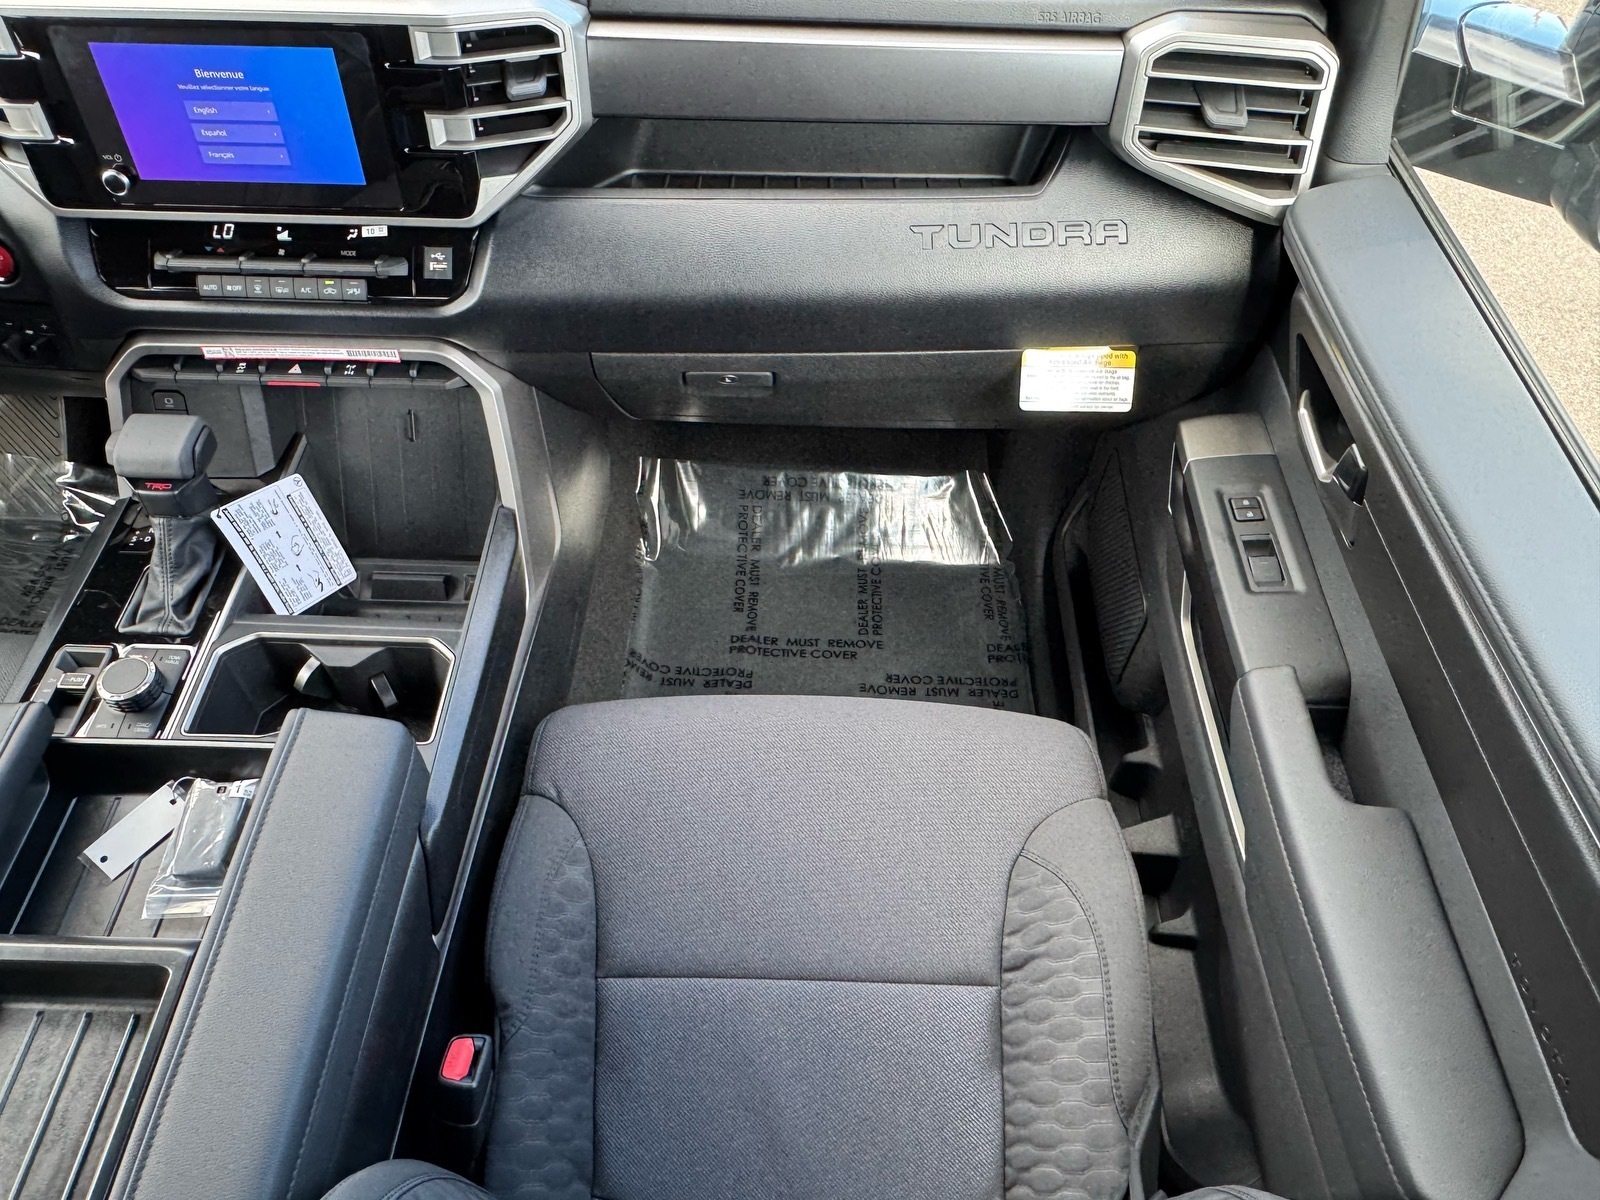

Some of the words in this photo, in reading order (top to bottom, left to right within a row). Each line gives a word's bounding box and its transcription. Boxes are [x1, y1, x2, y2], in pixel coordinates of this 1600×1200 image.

[1037, 11, 1058, 22] SRS
[1061, 11, 1102, 24] AIRBAG
[193, 68, 244, 79] Bienvenue
[193, 106, 218, 115] English
[201, 129, 228, 137] Español
[208, 151, 235, 159] Français
[212, 223, 235, 240] LO
[908, 218, 1129, 250] TUNDRA
[145, 482, 173, 491] TRD
[738, 489, 791, 501] REMOVE
[799, 490, 830, 502] MUST
[750, 505, 762, 552] DEALER
[131, 535, 138, 543] S
[144, 535, 152, 543] D
[735, 504, 749, 577] PROTECTIVE
[748, 559, 762, 586] MUST
[856, 568, 868, 594] MUST
[993, 567, 1006, 594] MUST
[732, 580, 746, 613] COVER
[871, 578, 883, 636] PROTECTIVE
[980, 586, 995, 621] COVER
[744, 591, 760, 632] REMOVE
[857, 599, 869, 636] DEALER
[996, 599, 1012, 642] REMOVE
[730, 634, 779, 646] DEALER
[786, 637, 821, 648] MUST
[827, 638, 884, 650] REMOVE
[729, 645, 807, 658] PROTECTIVE
[810, 649, 858, 660] COVER
[629, 647, 671, 674] COVER
[675, 666, 754, 679] PROTECTIVE
[885, 672, 933, 685] COVER
[660, 676, 696, 687] MUST
[703, 680, 753, 689] DEALER
[937, 675, 1018, 687] PROTECTIVE
[859, 683, 917, 696] REMOVE
[925, 687, 959, 697] MUST
[968, 688, 1019, 699] DEALER
